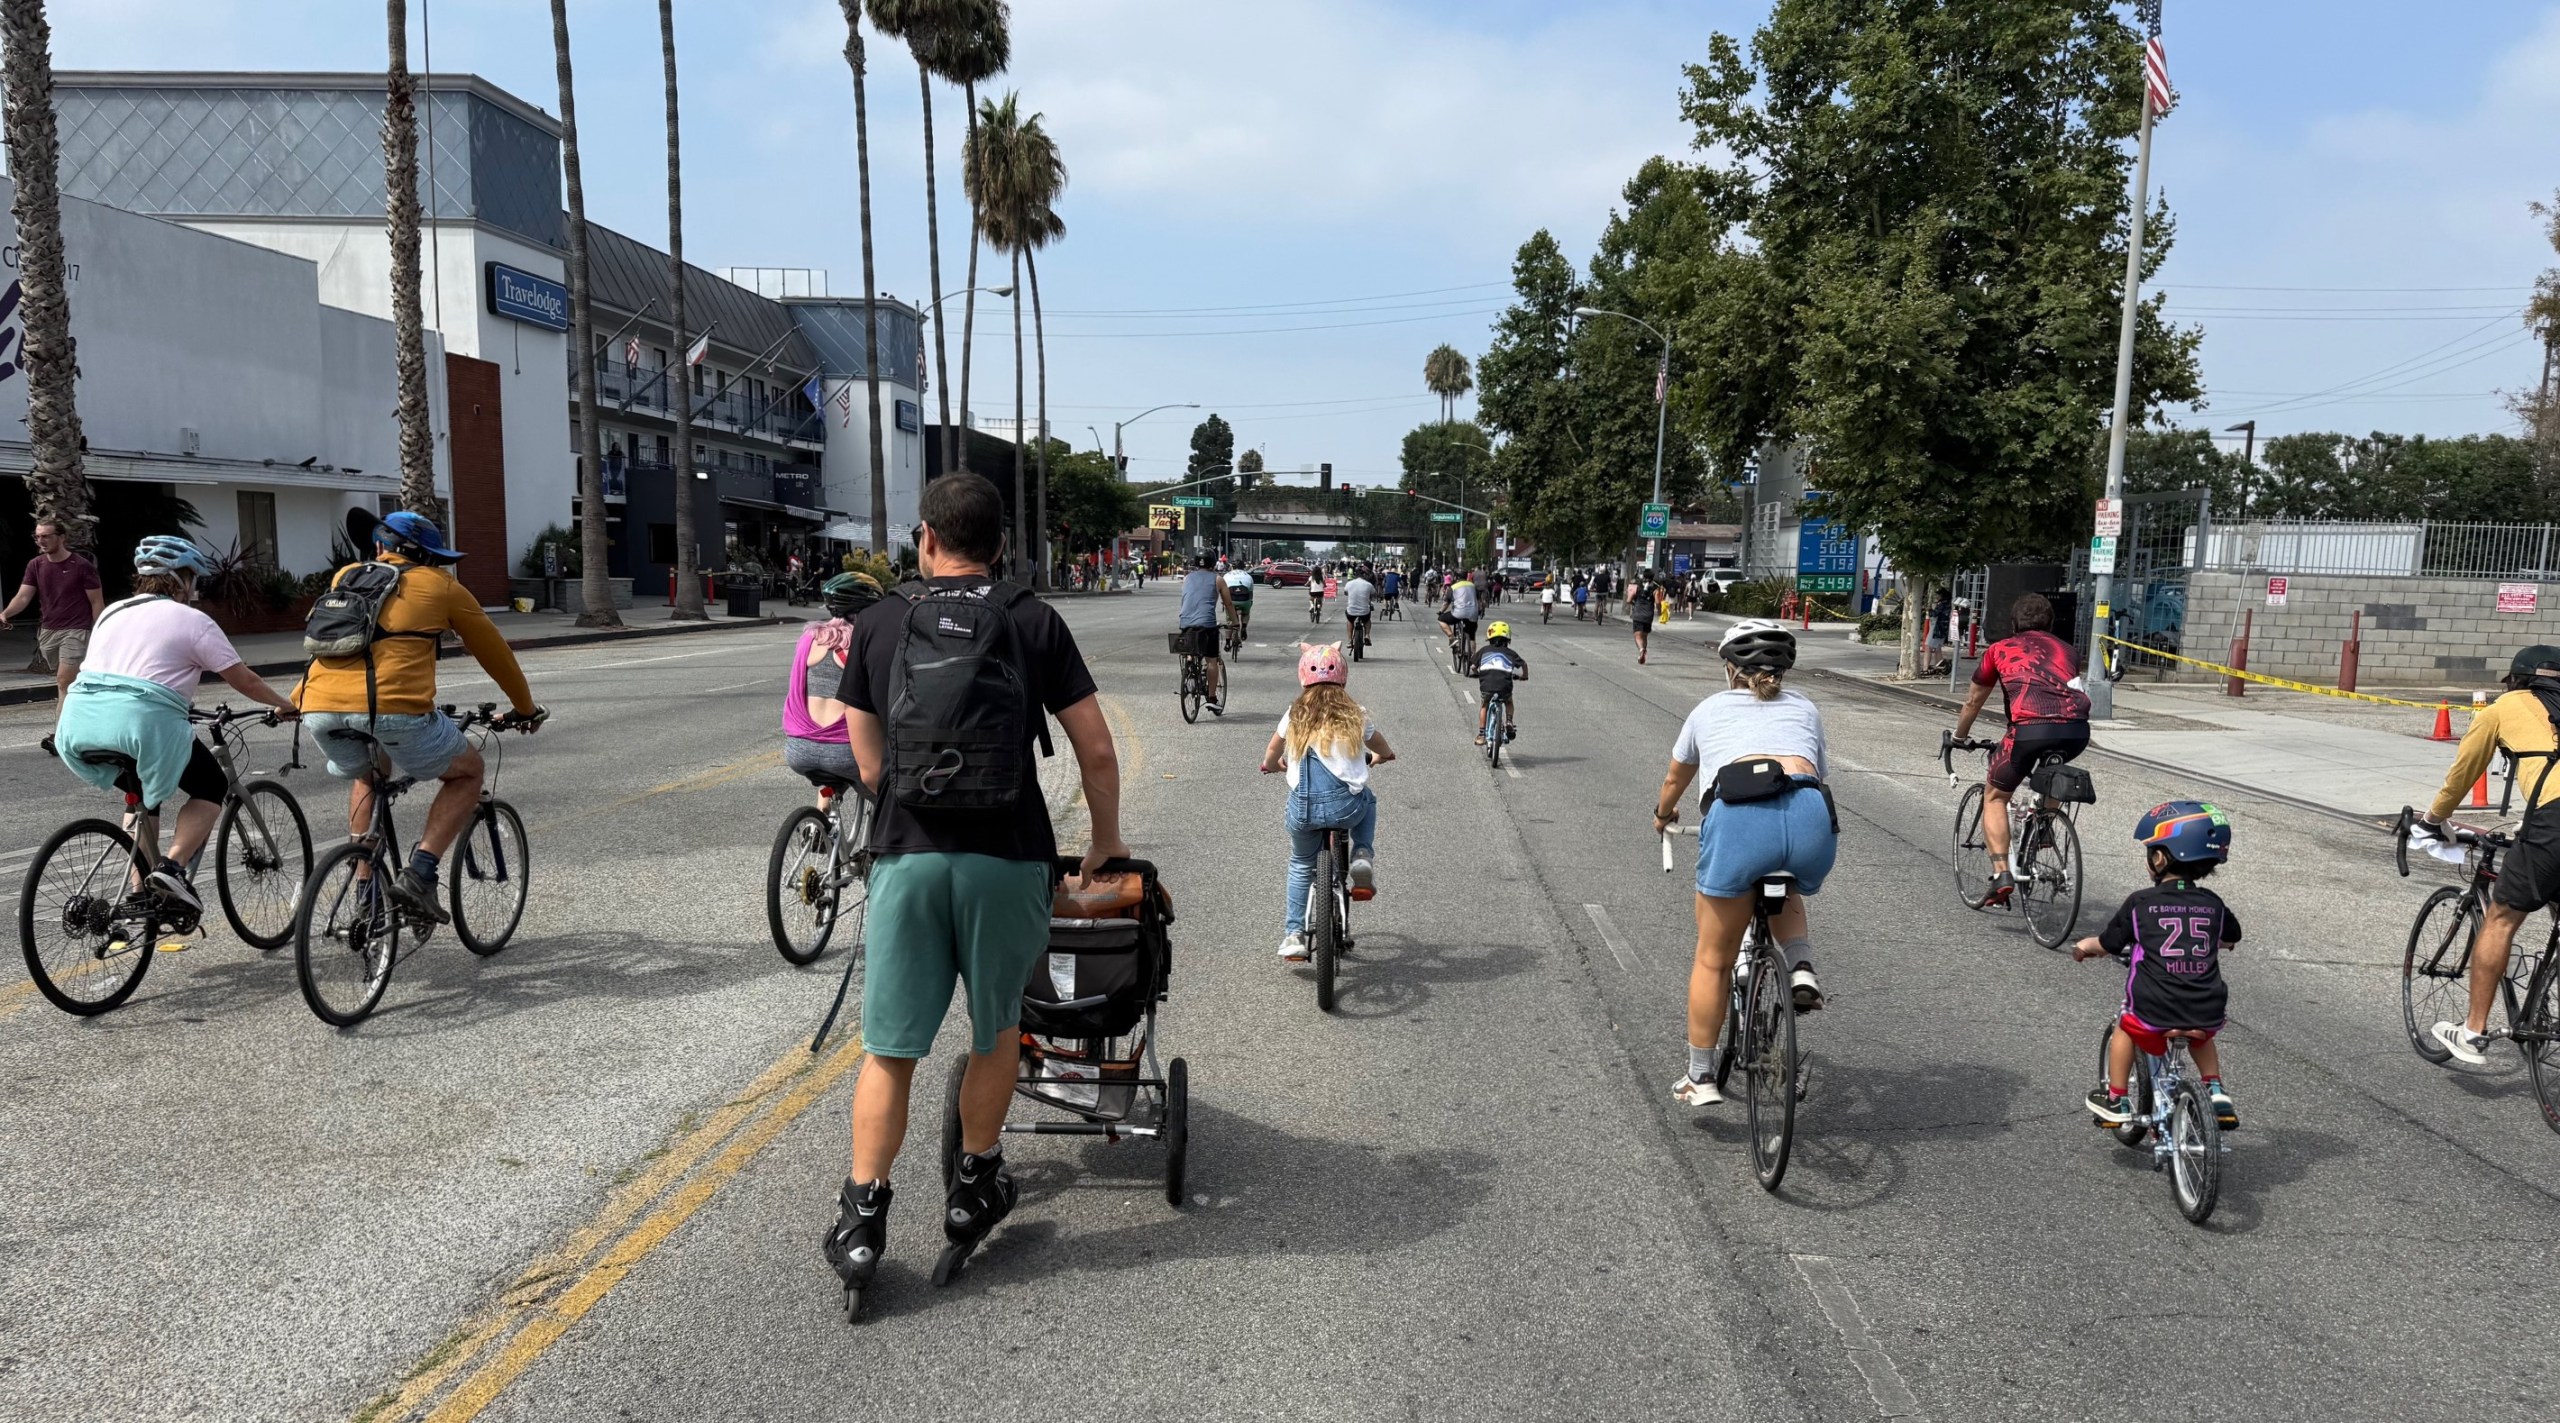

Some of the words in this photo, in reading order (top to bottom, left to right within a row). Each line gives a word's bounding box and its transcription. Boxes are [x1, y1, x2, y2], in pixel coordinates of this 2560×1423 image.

[501, 274, 562, 320] Travelodge
[775, 472, 809, 480] METRO
[1175, 497, 1203, 505] Sepulveda
[2098, 501, 2107, 510] NO
[1647, 516, 1664, 525] 405
[2149, 905, 2158, 913] FC
[2160, 905, 2187, 913] BAYERN
[2158, 917, 2211, 957] 25
[2166, 960, 2209, 974] MÜLLER
